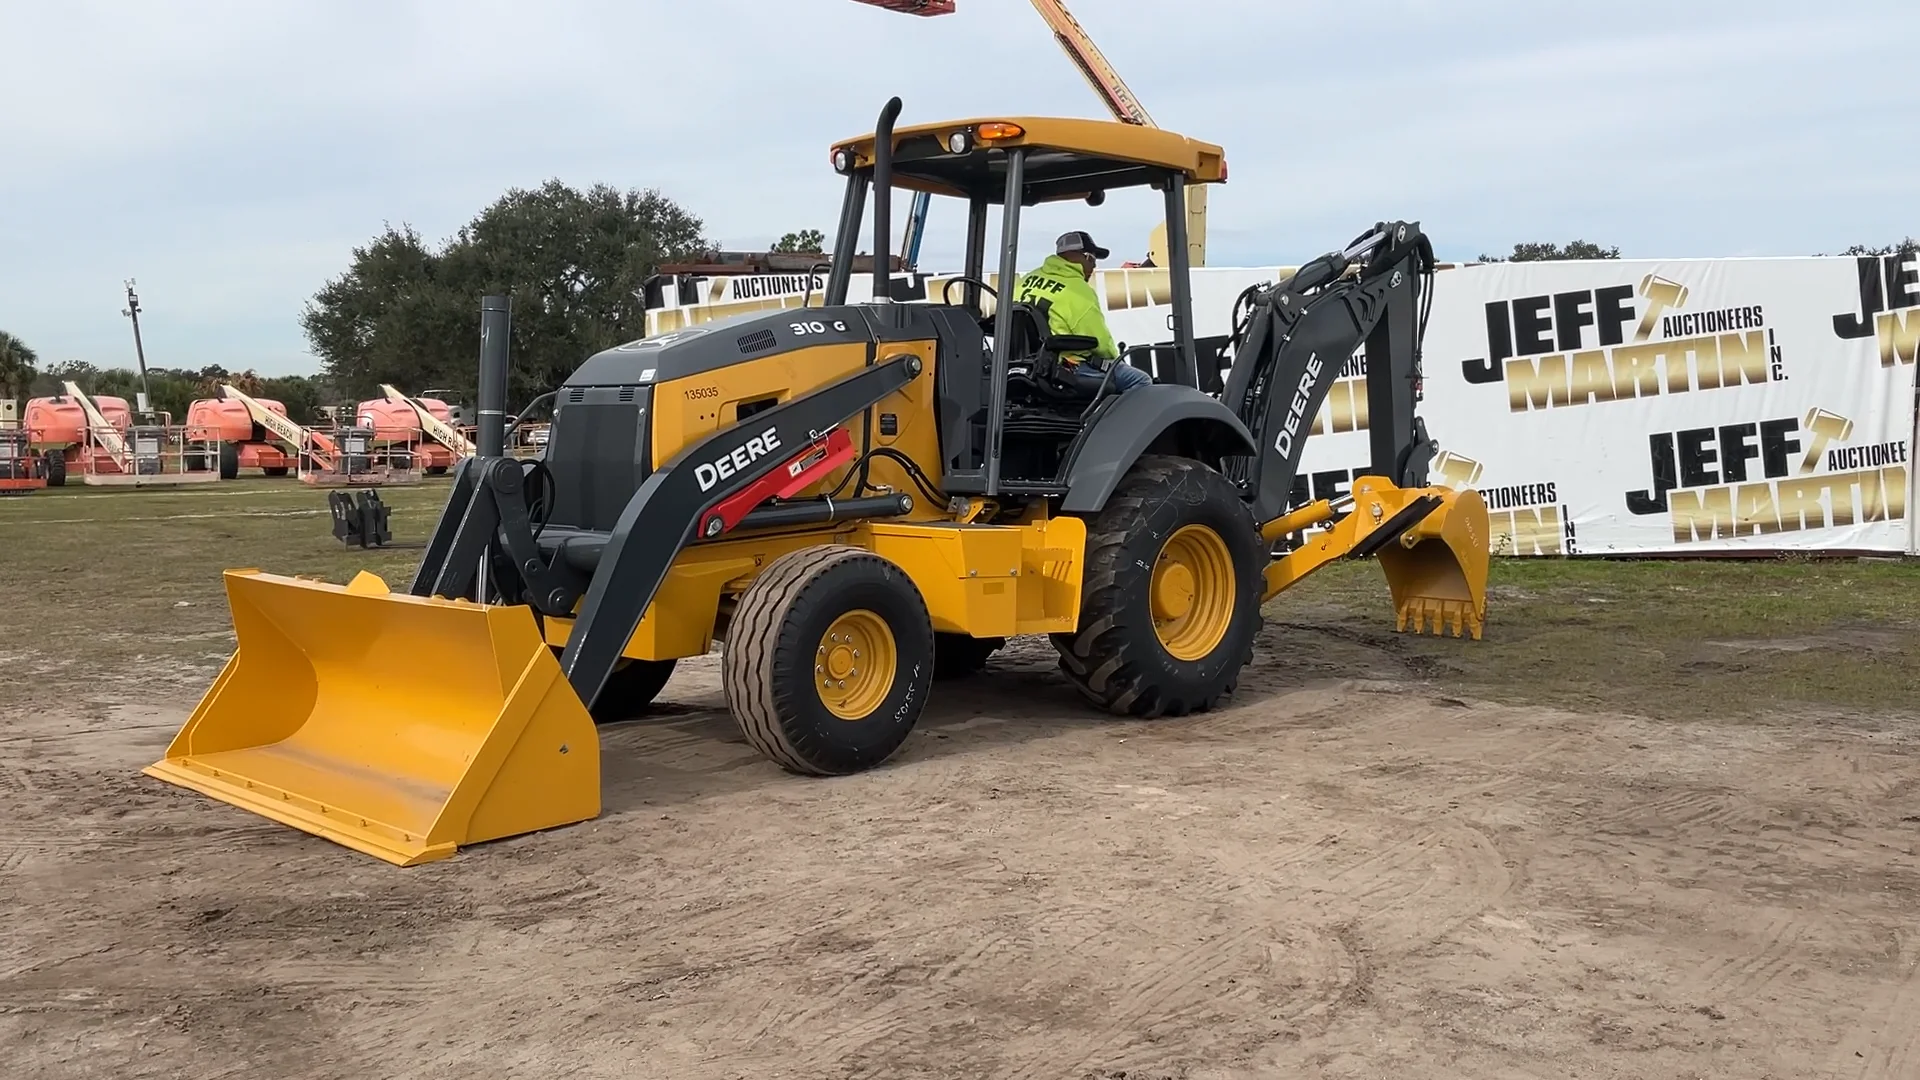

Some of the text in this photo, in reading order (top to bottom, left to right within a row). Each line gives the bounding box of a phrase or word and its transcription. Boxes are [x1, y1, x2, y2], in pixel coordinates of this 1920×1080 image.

[1021, 274, 1066, 295] STAFF
[1832, 252, 1920, 340] JE
[789, 320, 847, 336] 310 G
[1462, 284, 1636, 384] JEFF
[1662, 305, 1764, 338] AUCTIONEERS
[1505, 330, 1768, 413] MARTIN
[684, 386, 719, 401] 135035
[1274, 351, 1324, 460] DEERE
[264, 415, 293, 441] HIGH REACH
[694, 426, 782, 493] DEERE
[1625, 417, 1802, 515] JEFF
[1828, 440, 1908, 471] AUCTIONEE
[1479, 482, 1557, 509] CTIONEERS
